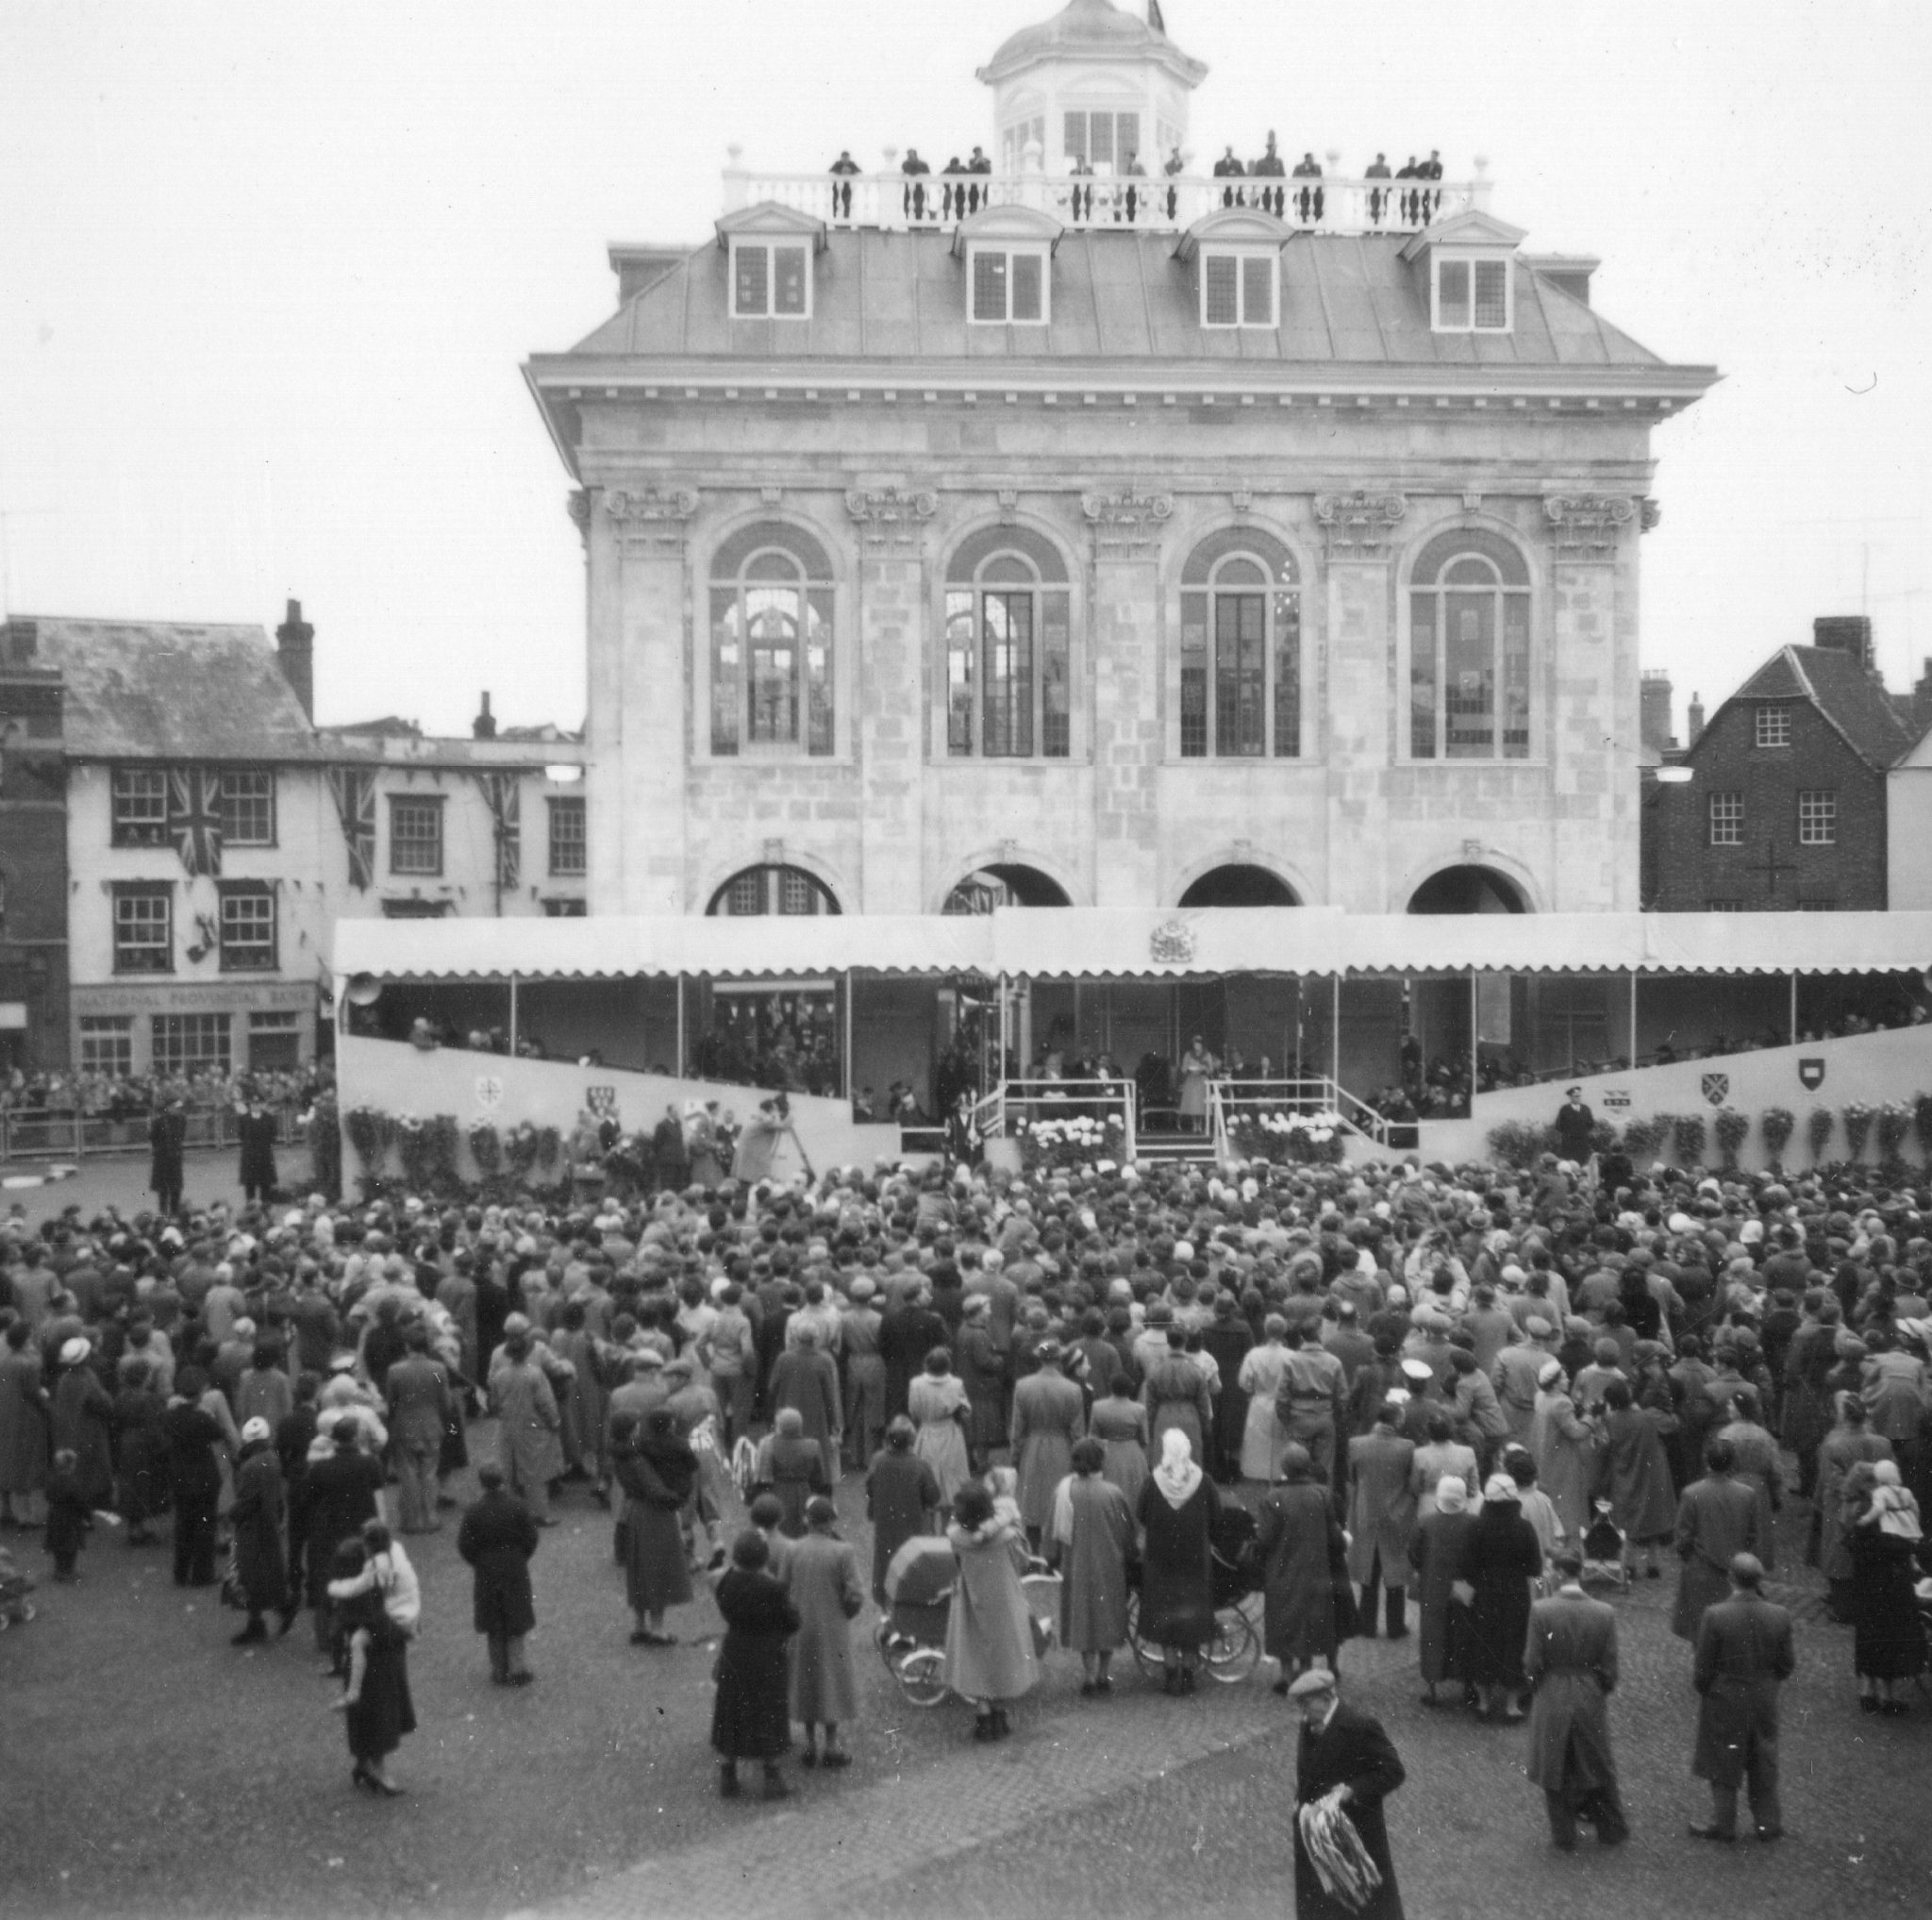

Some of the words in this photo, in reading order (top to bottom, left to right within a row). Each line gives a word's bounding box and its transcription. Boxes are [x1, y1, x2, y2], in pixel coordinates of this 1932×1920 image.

[78, 993, 160, 1007] NATIONAL
[170, 992, 258, 1005] PROVINCIAL
[270, 990, 309, 1003] BANK
